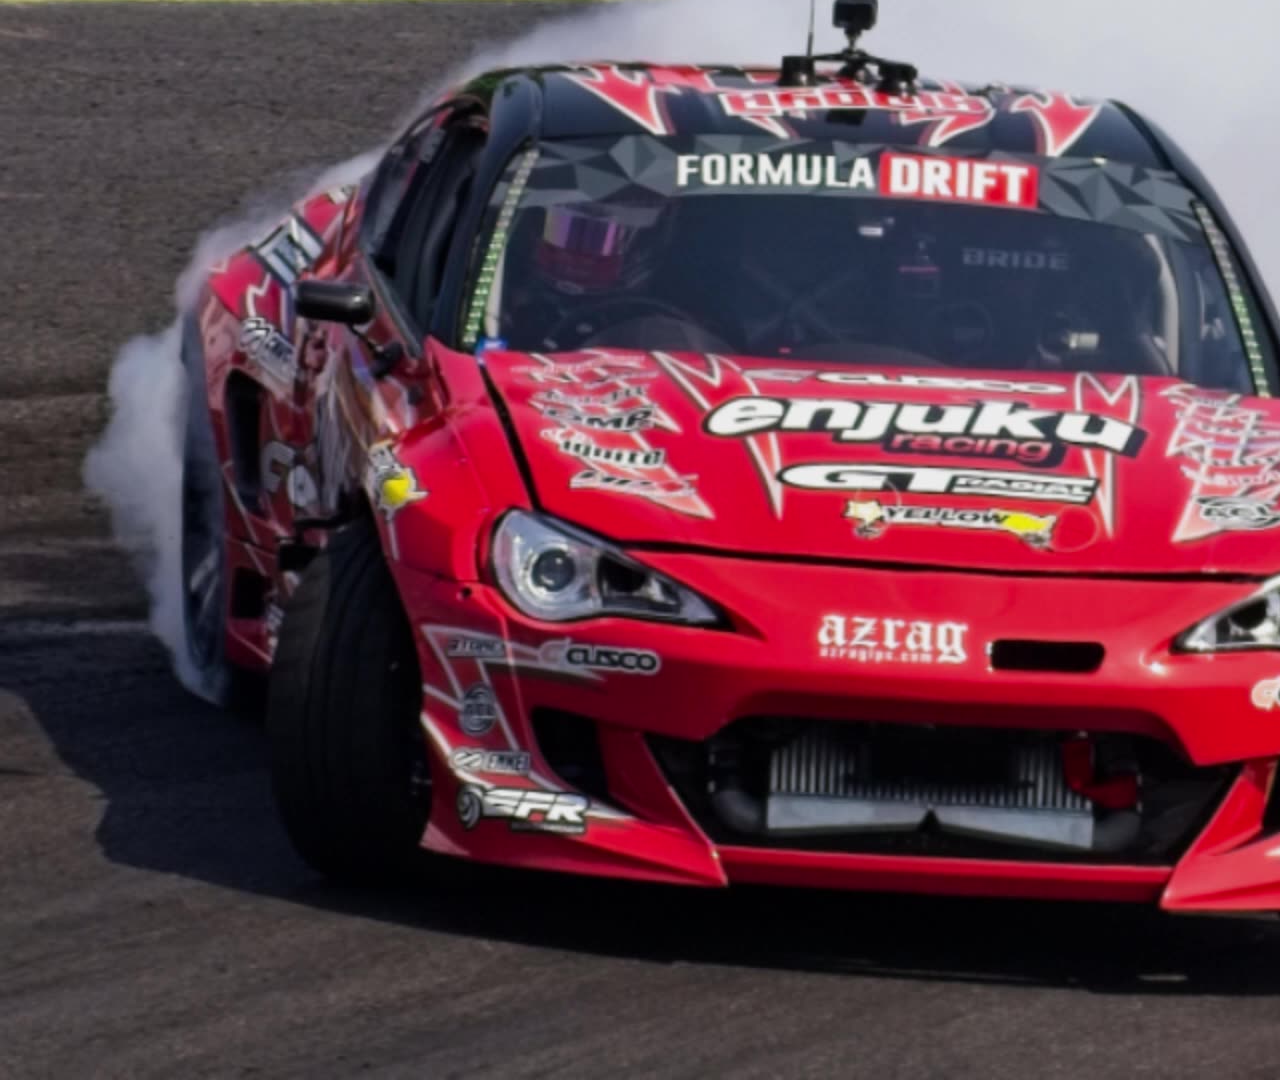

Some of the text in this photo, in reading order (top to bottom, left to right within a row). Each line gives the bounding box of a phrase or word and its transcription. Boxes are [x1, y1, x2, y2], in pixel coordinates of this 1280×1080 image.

[675, 153, 1029, 204] FORMULA DRIFT
[962, 246, 1071, 270] BRIDE
[705, 396, 1139, 453] enjuku
[890, 434, 1052, 461] racing
[778, 463, 1092, 496] GT RADIAL
[883, 505, 1008, 526] YELLOW
[817, 613, 969, 664] azrag
[565, 645, 658, 671] CUSCO
